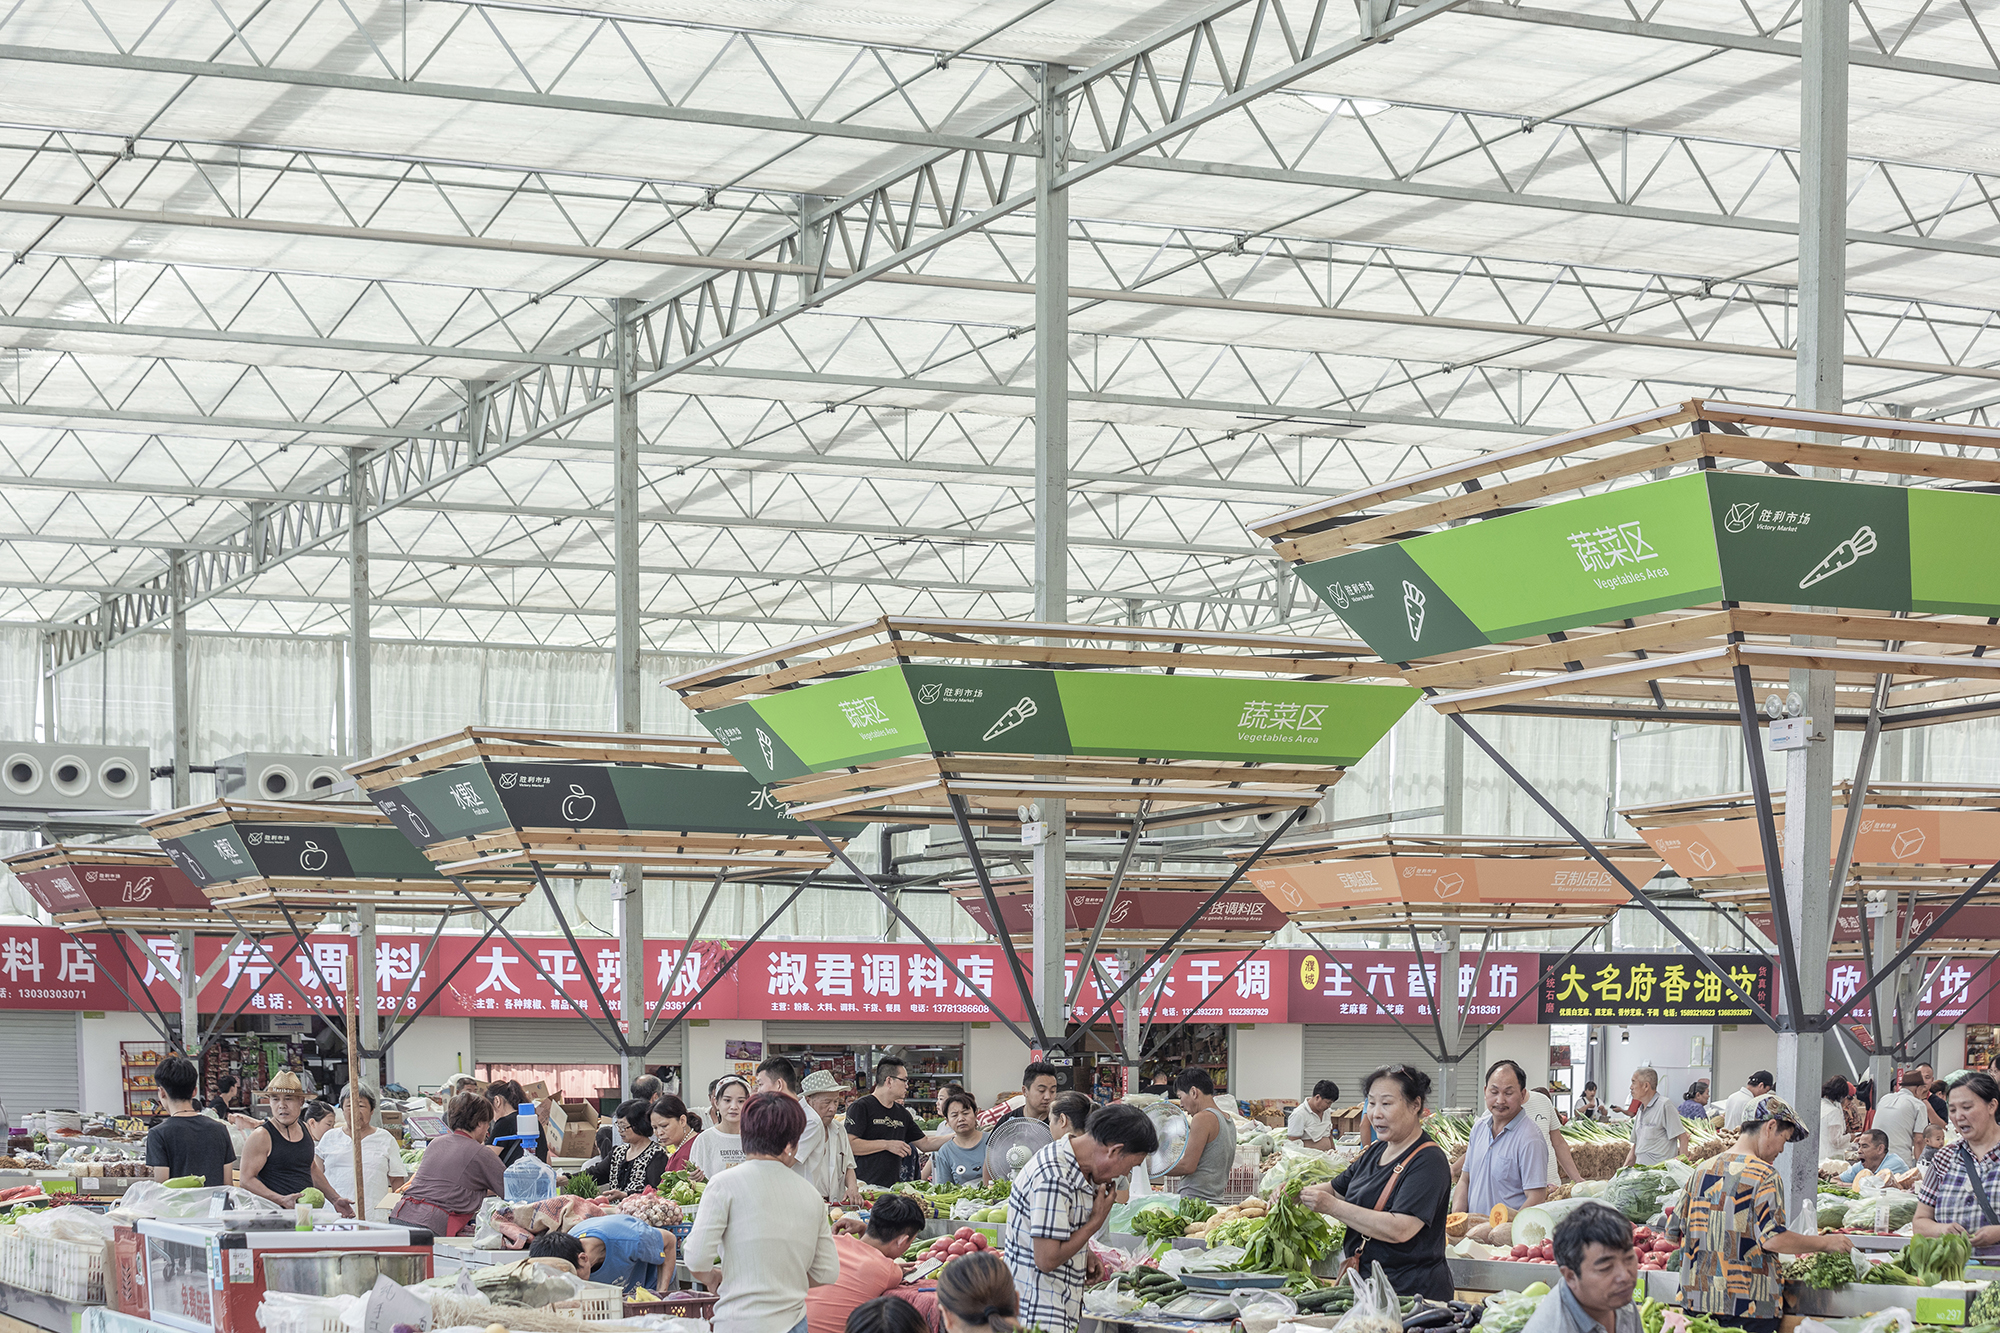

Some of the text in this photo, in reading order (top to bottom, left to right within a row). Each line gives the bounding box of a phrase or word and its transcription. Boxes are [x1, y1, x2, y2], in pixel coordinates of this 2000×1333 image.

[1758, 509, 1811, 526] 胜利市场
[1756, 523, 1776, 532] Victory
[1567, 520, 1659, 572] 蔬菜区
[1593, 565, 1670, 590] Vegetables Area
[1344, 580, 1375, 597] 胜利市场
[943, 688, 984, 698] 胜利市场
[838, 696, 889, 729] 蔬菜区
[1237, 700, 1329, 731] 蔬菜区
[858, 726, 899, 742] Vegetables Area
[1238, 732, 1319, 744] Vegetables Area
[1336, 870, 1379, 888] 豆制品区
[1551, 871, 1614, 887] 豆制品区
[767, 951, 994, 998] 淑君调料店
[1556, 963, 1757, 1003] 大名府香油坊
[1339, 1004, 1368, 1015] 芝麻酱
[1946, 1309, 1962, 1321] 297
